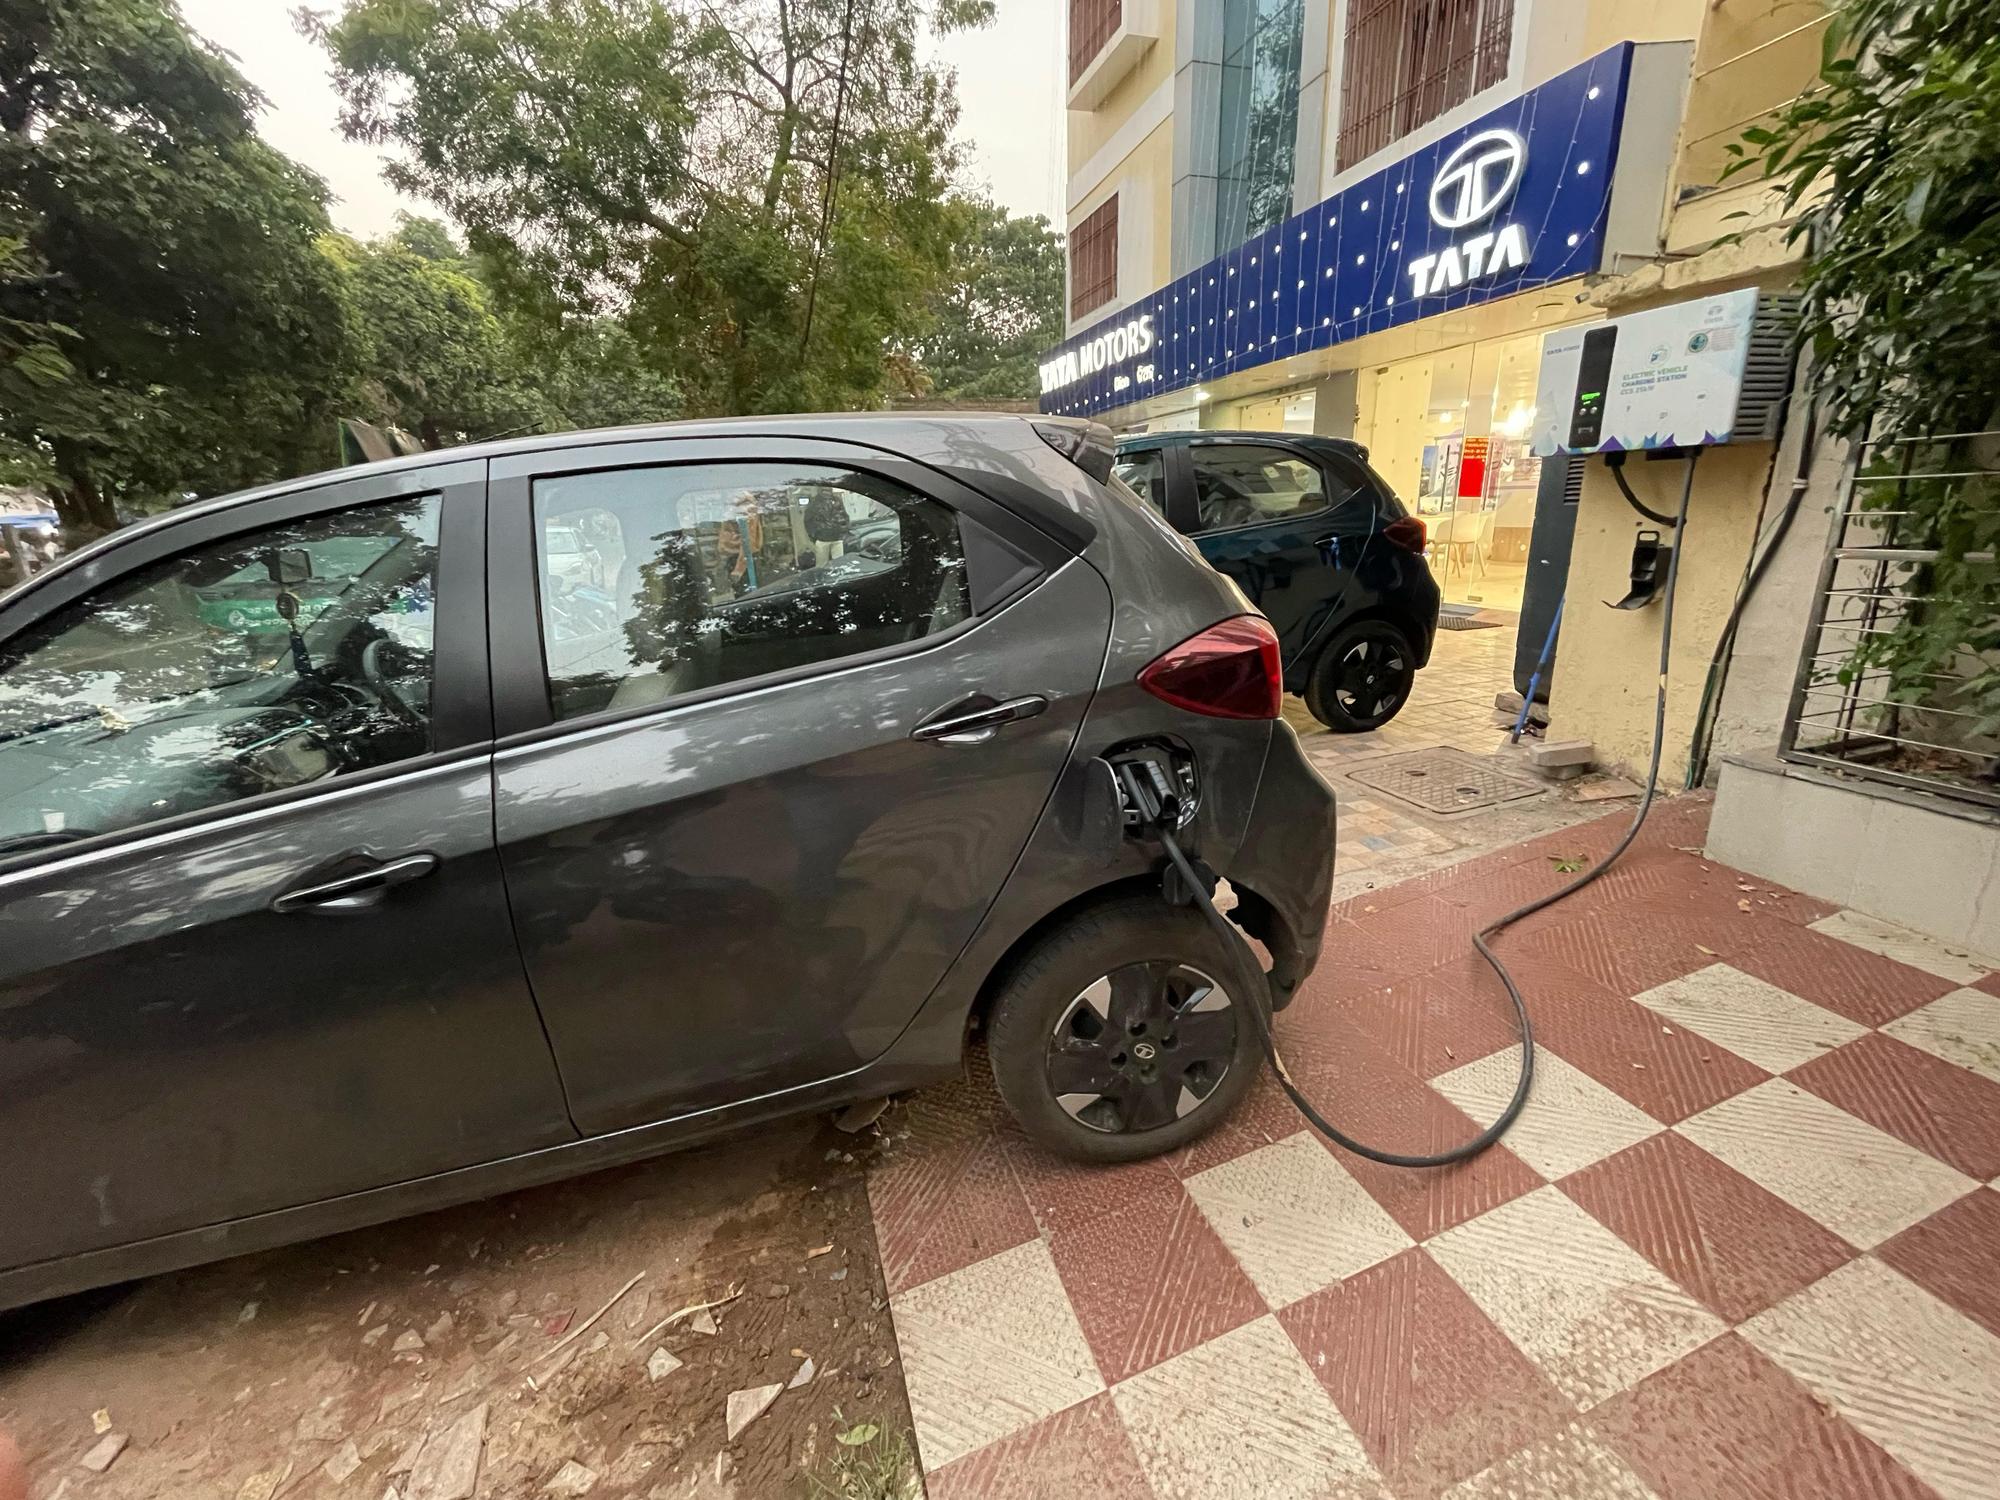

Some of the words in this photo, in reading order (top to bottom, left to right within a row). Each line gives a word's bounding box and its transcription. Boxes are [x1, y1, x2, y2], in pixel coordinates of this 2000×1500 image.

[1408, 223, 1528, 298] TATA
[1039, 351, 1079, 395] TATA
[1079, 314, 1153, 377] MOTORS
[1656, 373, 1688, 383] STATION
